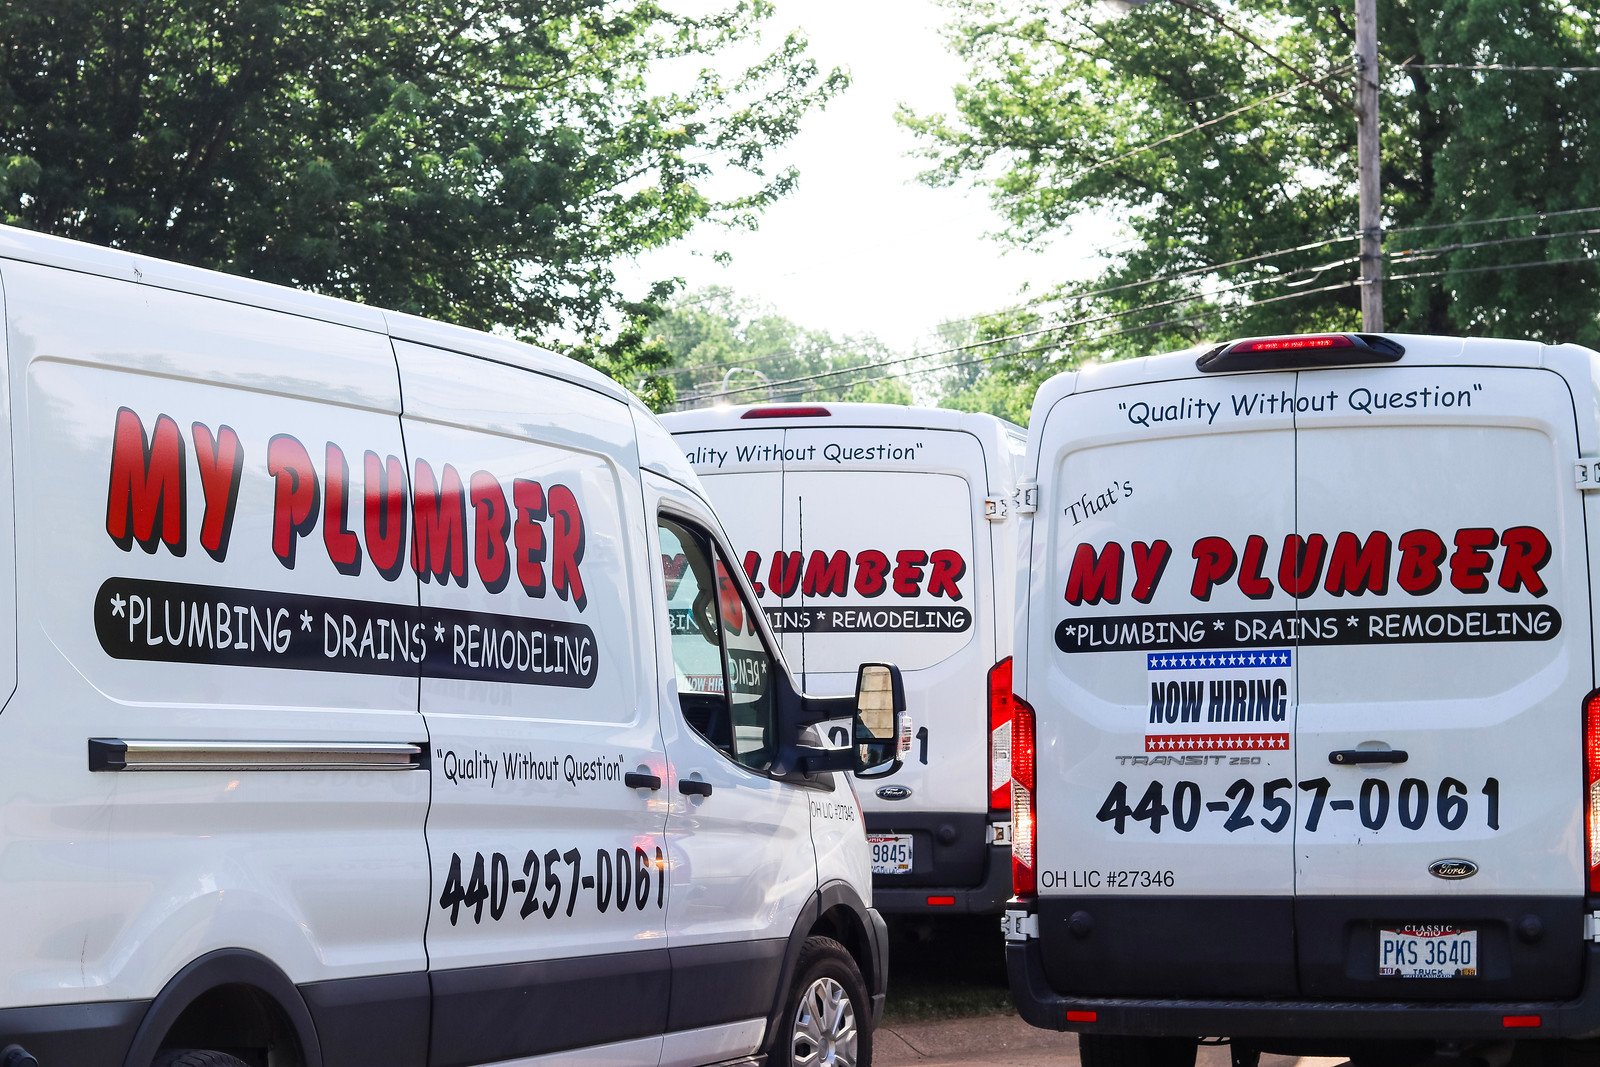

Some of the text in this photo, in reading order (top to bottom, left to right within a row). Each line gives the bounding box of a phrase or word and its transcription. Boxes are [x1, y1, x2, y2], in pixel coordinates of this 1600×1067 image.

[1118, 382, 1484, 427] "Quality Without Question"
[736, 443, 816, 463] Without
[823, 442, 923, 465] Question"
[105, 406, 244, 563] MY
[267, 433, 587, 612] PLUMBER
[1063, 479, 1134, 526] That's
[1064, 524, 1553, 607] MY PLUMBER
[832, 610, 966, 628] REMODELING
[1234, 618, 1338, 641] DRAINS
[1368, 611, 1553, 638] REMODELING
[322, 613, 427, 664] DRAINS
[452, 624, 593, 676] REMODELING
[1150, 678, 1287, 724] NOW HIRING
[436, 749, 625, 788] "Quality Without Question"
[1115, 755, 1261, 766] TRANSIT 250
[1096, 777, 1500, 834] 440-257-0061
[872, 844, 906, 863] 9845
[1439, 863, 1467, 875] Ford
[440, 846, 664, 926] 440-257-0061
[1041, 871, 1175, 888] OH LIC #27346
[1404, 925, 1453, 933] CLASSIC
[1383, 940, 1471, 965] PKS 3640
